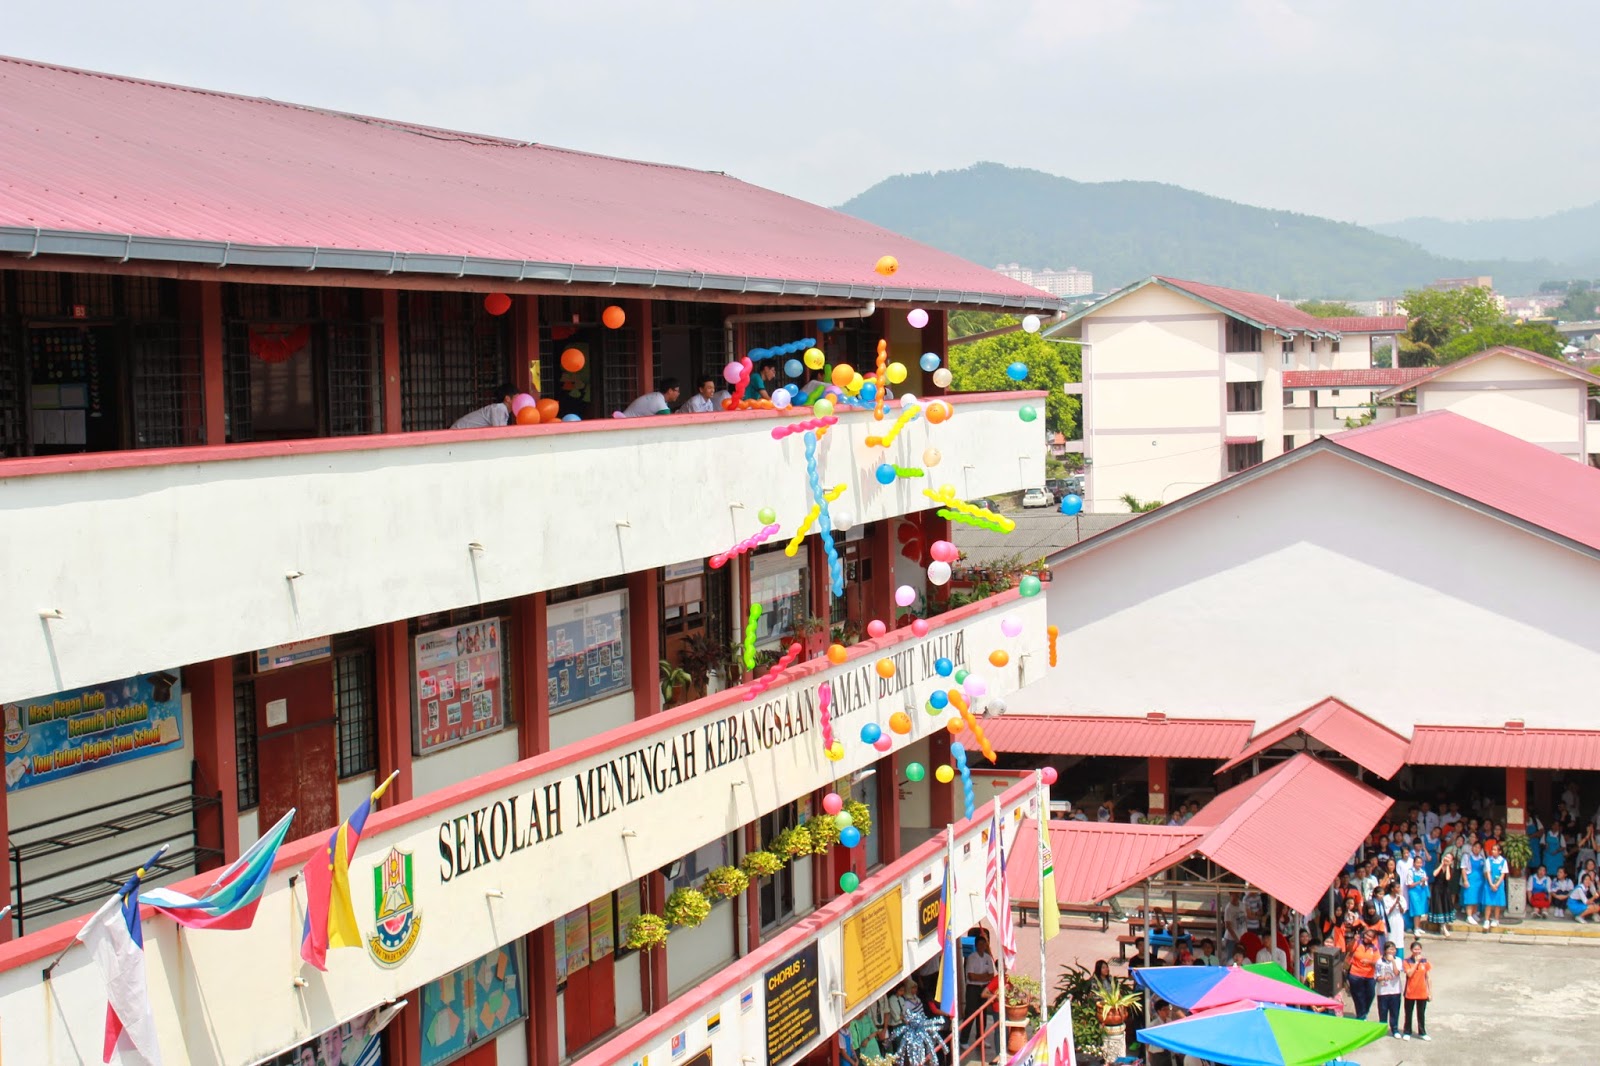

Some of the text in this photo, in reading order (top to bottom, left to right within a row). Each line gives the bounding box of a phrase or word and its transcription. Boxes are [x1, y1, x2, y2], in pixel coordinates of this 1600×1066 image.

[28, 691, 106, 725] Masa Depan Anda
[68, 702, 149, 738] Bermula Di Sekolah
[32, 724, 162, 775] Your Future Begins From School
[438, 781, 563, 885] SEKOLAH
[574, 729, 698, 828] MENENGAH
[703, 685, 815, 773] KEBANGSAAN
[820, 664, 872, 722] AMAN
[768, 960, 801, 991] CHORUS
